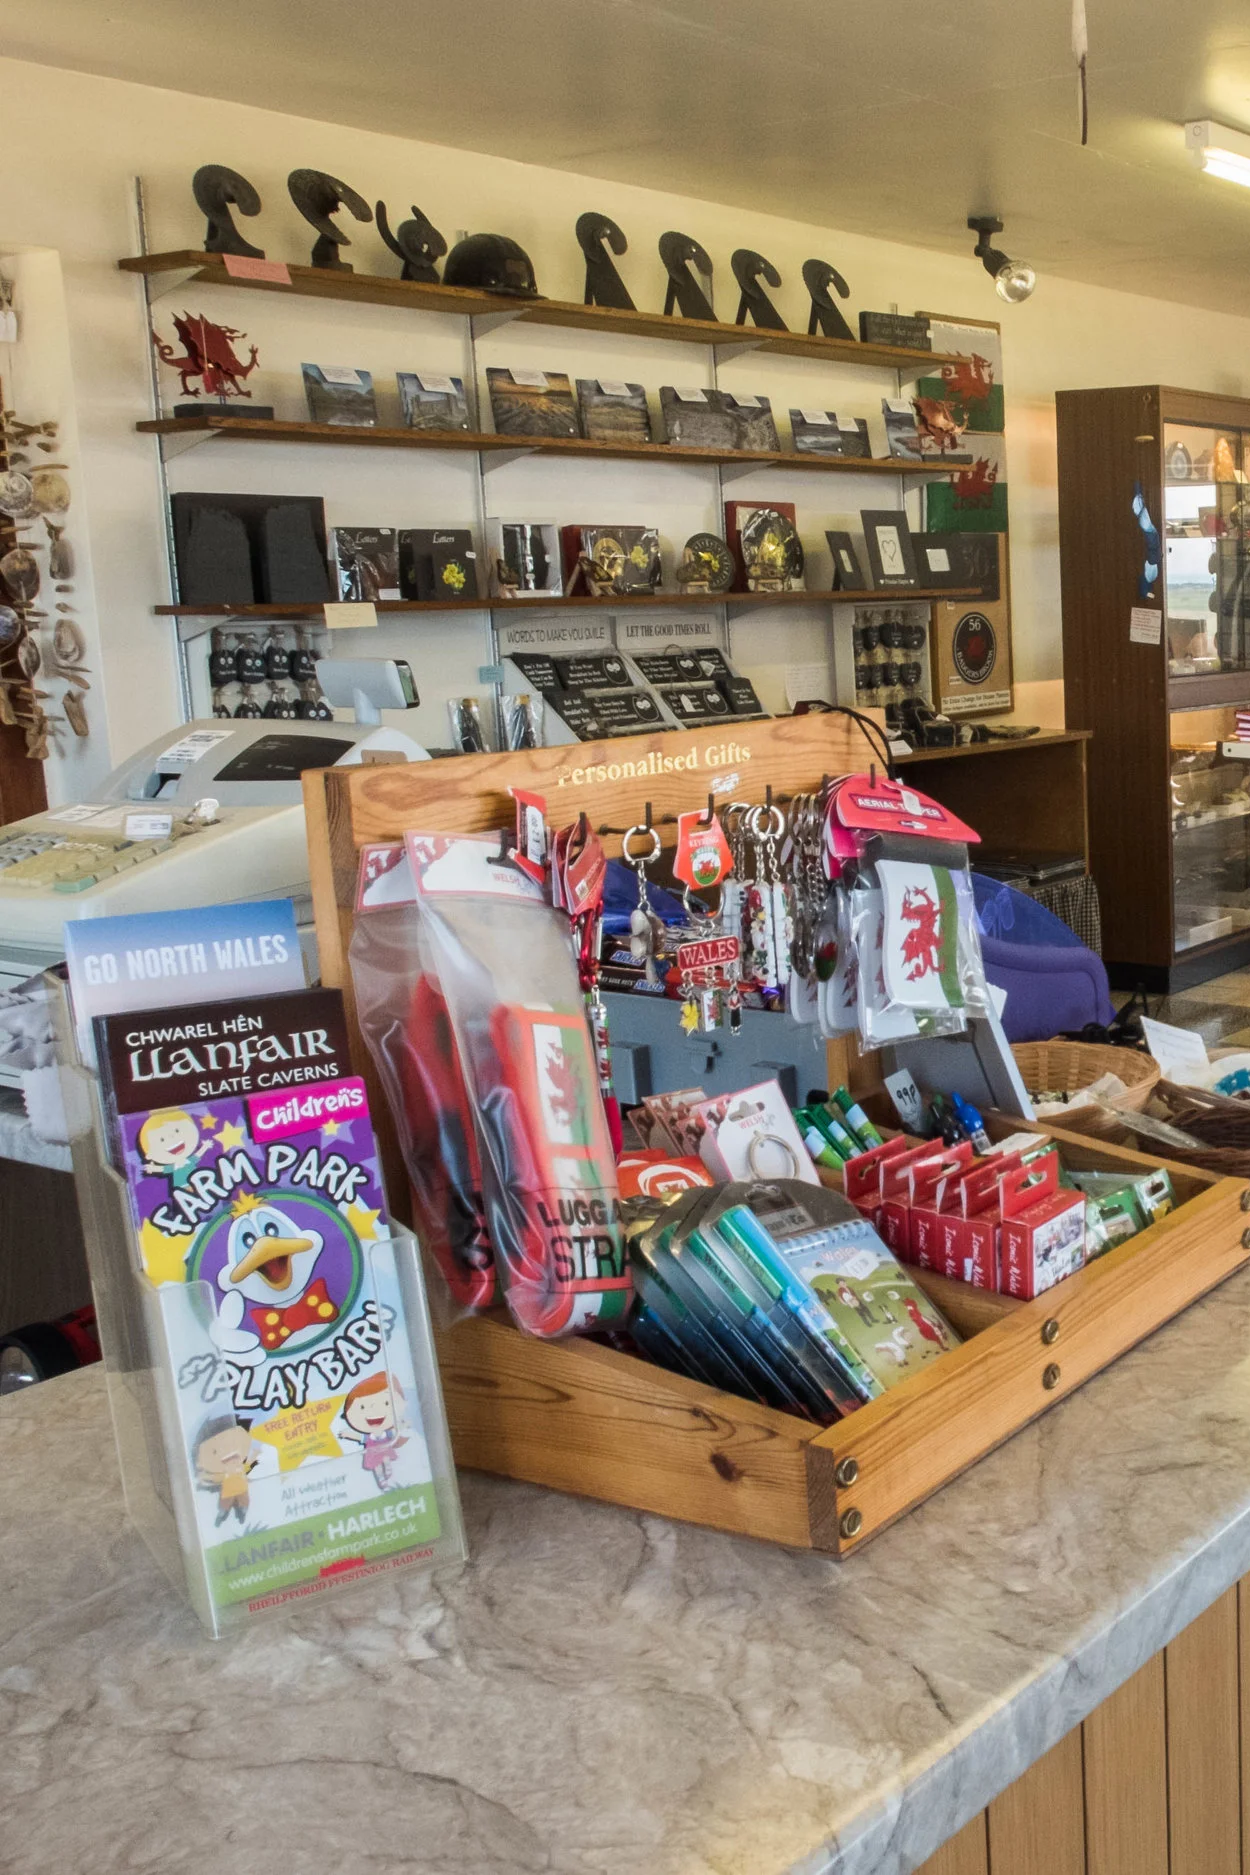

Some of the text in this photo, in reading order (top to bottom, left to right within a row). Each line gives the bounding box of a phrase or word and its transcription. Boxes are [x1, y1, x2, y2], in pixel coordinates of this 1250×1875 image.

[507, 627, 605, 644] WORDS TO MAKE YOU SMILE
[626, 623, 711, 638] LET THE GOOD TIMES ROLL
[969, 618, 981, 631] 56
[557, 747, 698, 787] Personalised
[704, 743, 751, 767] Gifts
[84, 934, 289, 985] GO NORTH WALES
[681, 940, 735, 966] WALES
[126, 1014, 263, 1047] CHWAREL HÊN
[198, 1063, 339, 1096] SLATE CAVERNS
[152, 1145, 368, 1236] FARM PARK
[971, 1232, 984, 1264] Iconic
[1008, 1233, 1022, 1264] Iconic
[200, 1358, 310, 1411] PLAY
[310, 1300, 397, 1390] BARN
[264, 1401, 332, 1433] FREE RETURN
[284, 1421, 318, 1441] ENTRY
[281, 1487, 296, 1501] All
[285, 1491, 348, 1517] Attraction
[327, 1495, 427, 1541] HARLECH
[228, 1522, 418, 1591] www.childrensfarmpark.co.uk
[391, 1547, 435, 1568] RAILWAY
